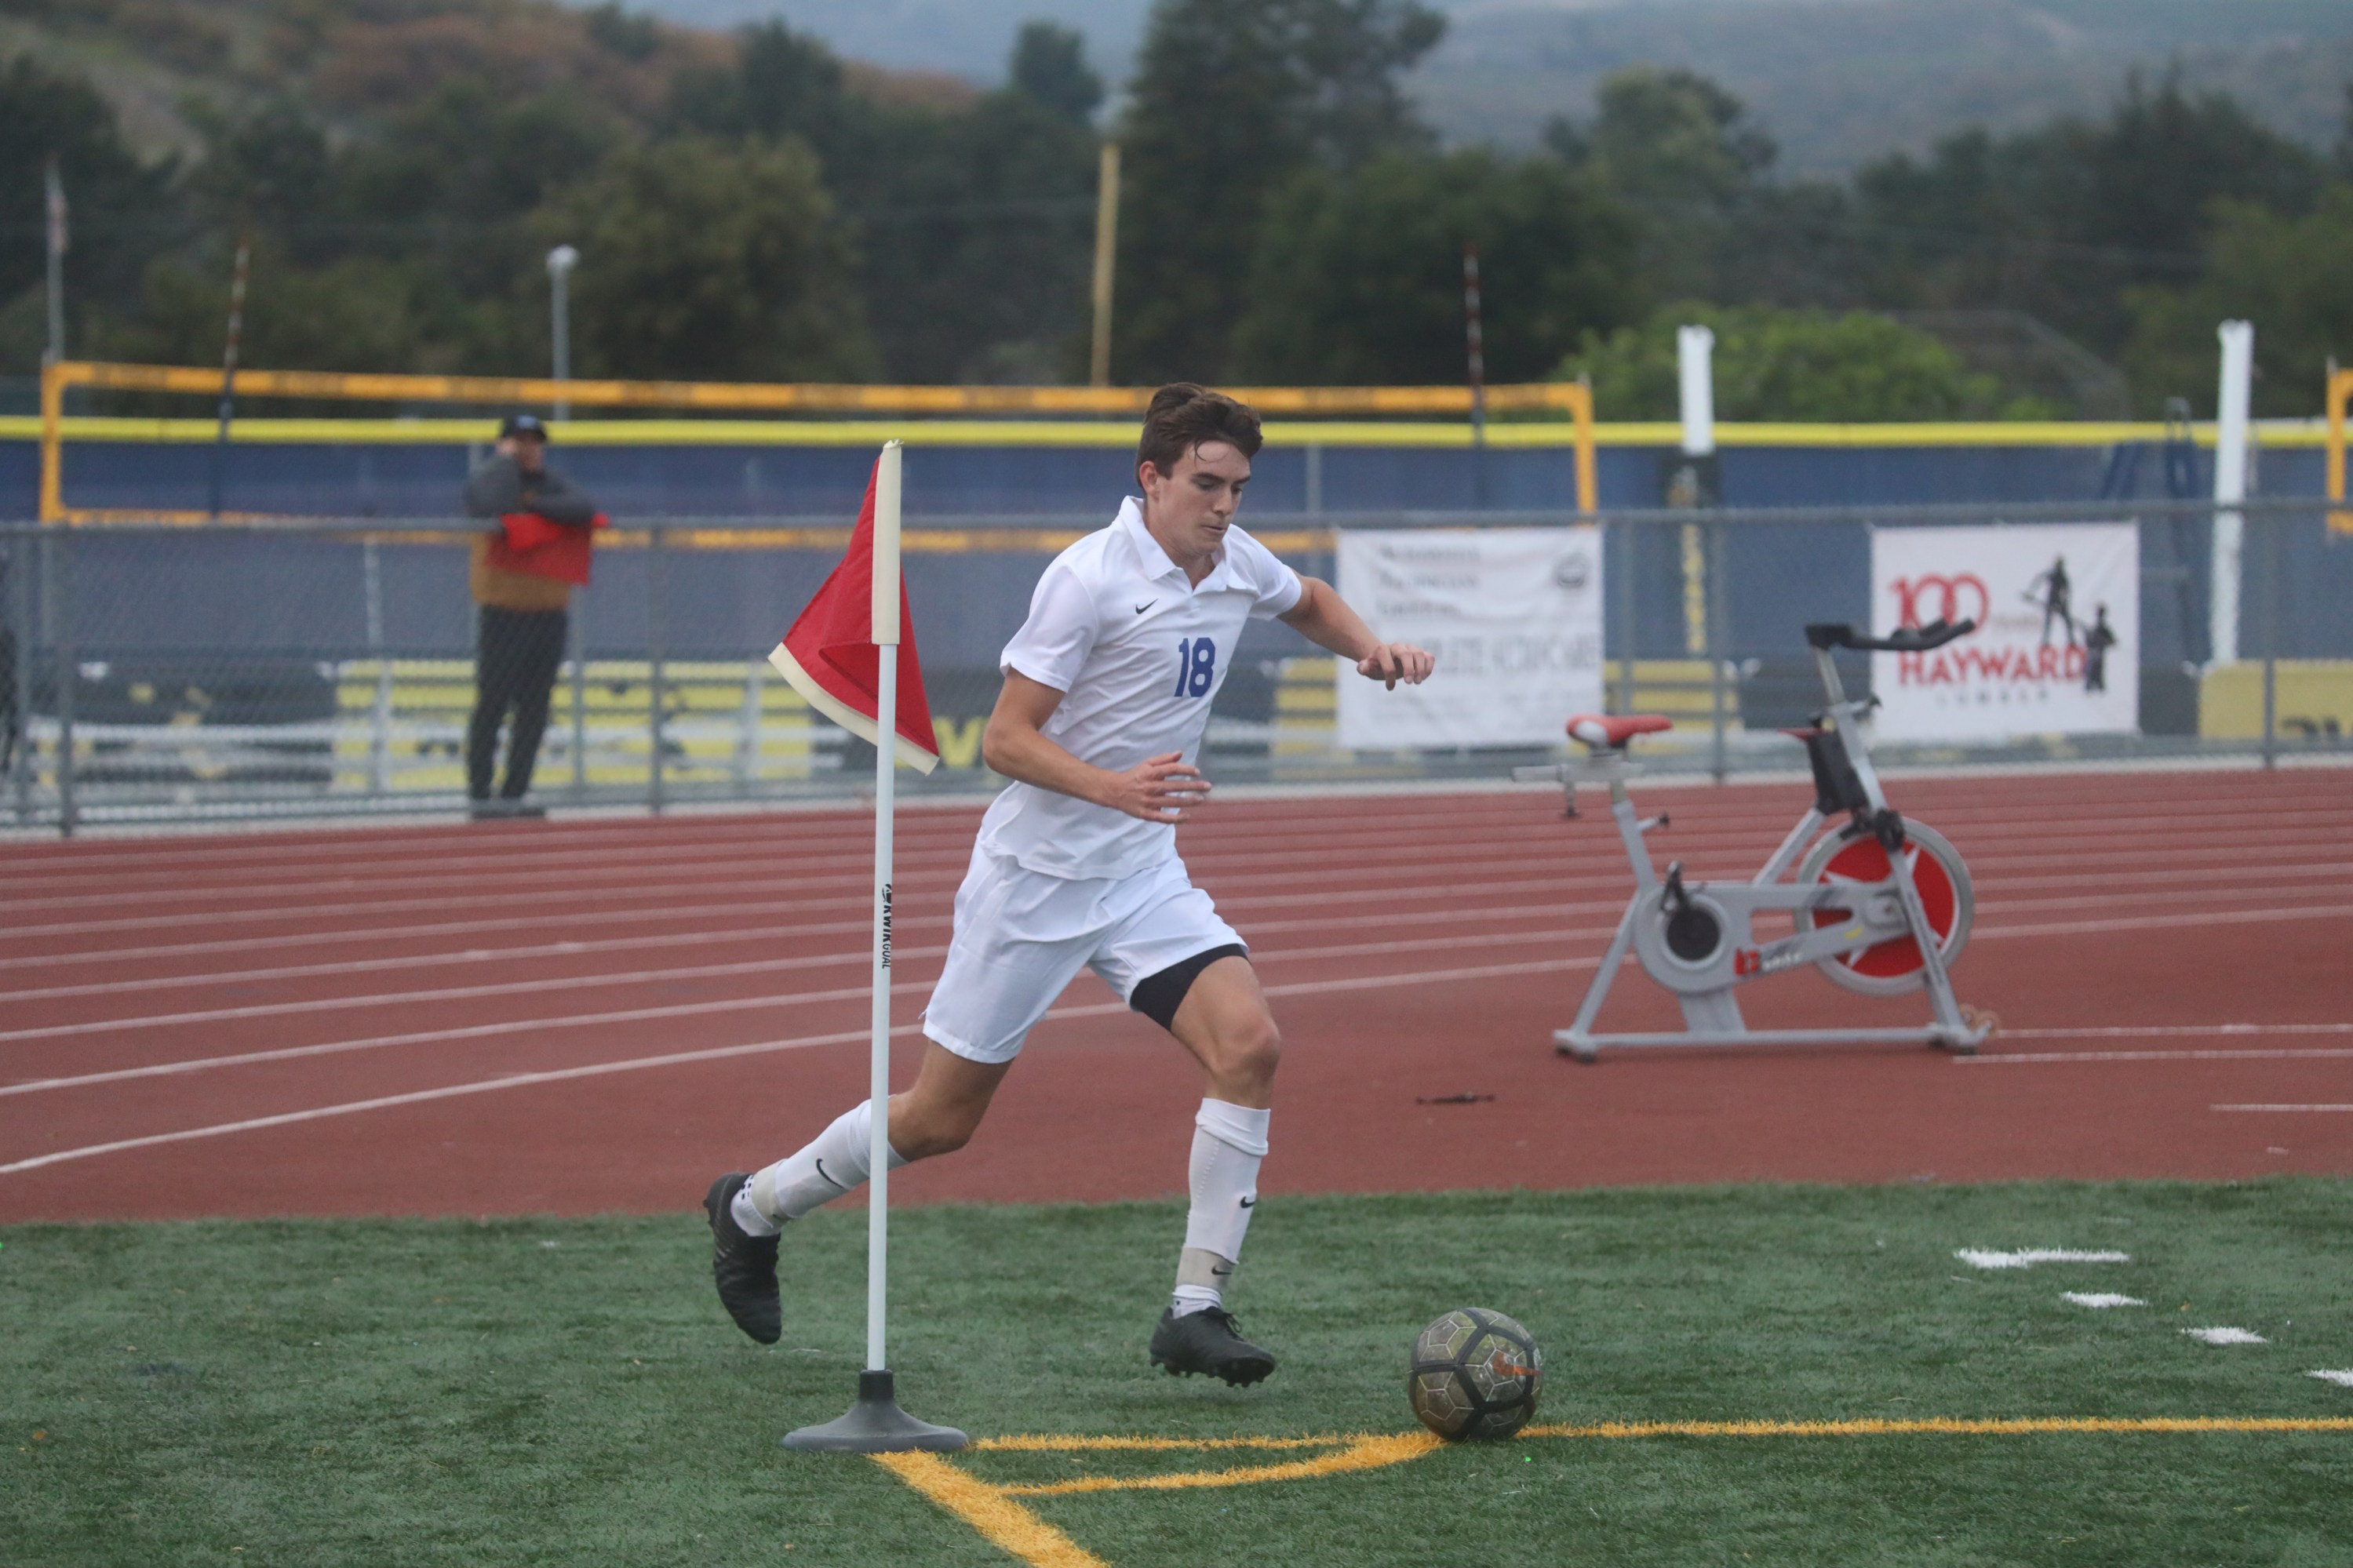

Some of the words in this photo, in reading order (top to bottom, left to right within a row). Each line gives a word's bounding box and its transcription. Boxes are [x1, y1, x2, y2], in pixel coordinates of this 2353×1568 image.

[1889, 572, 1989, 637] 100
[1174, 637, 1215, 697] 18
[1897, 643, 2087, 687] HAYWARD
